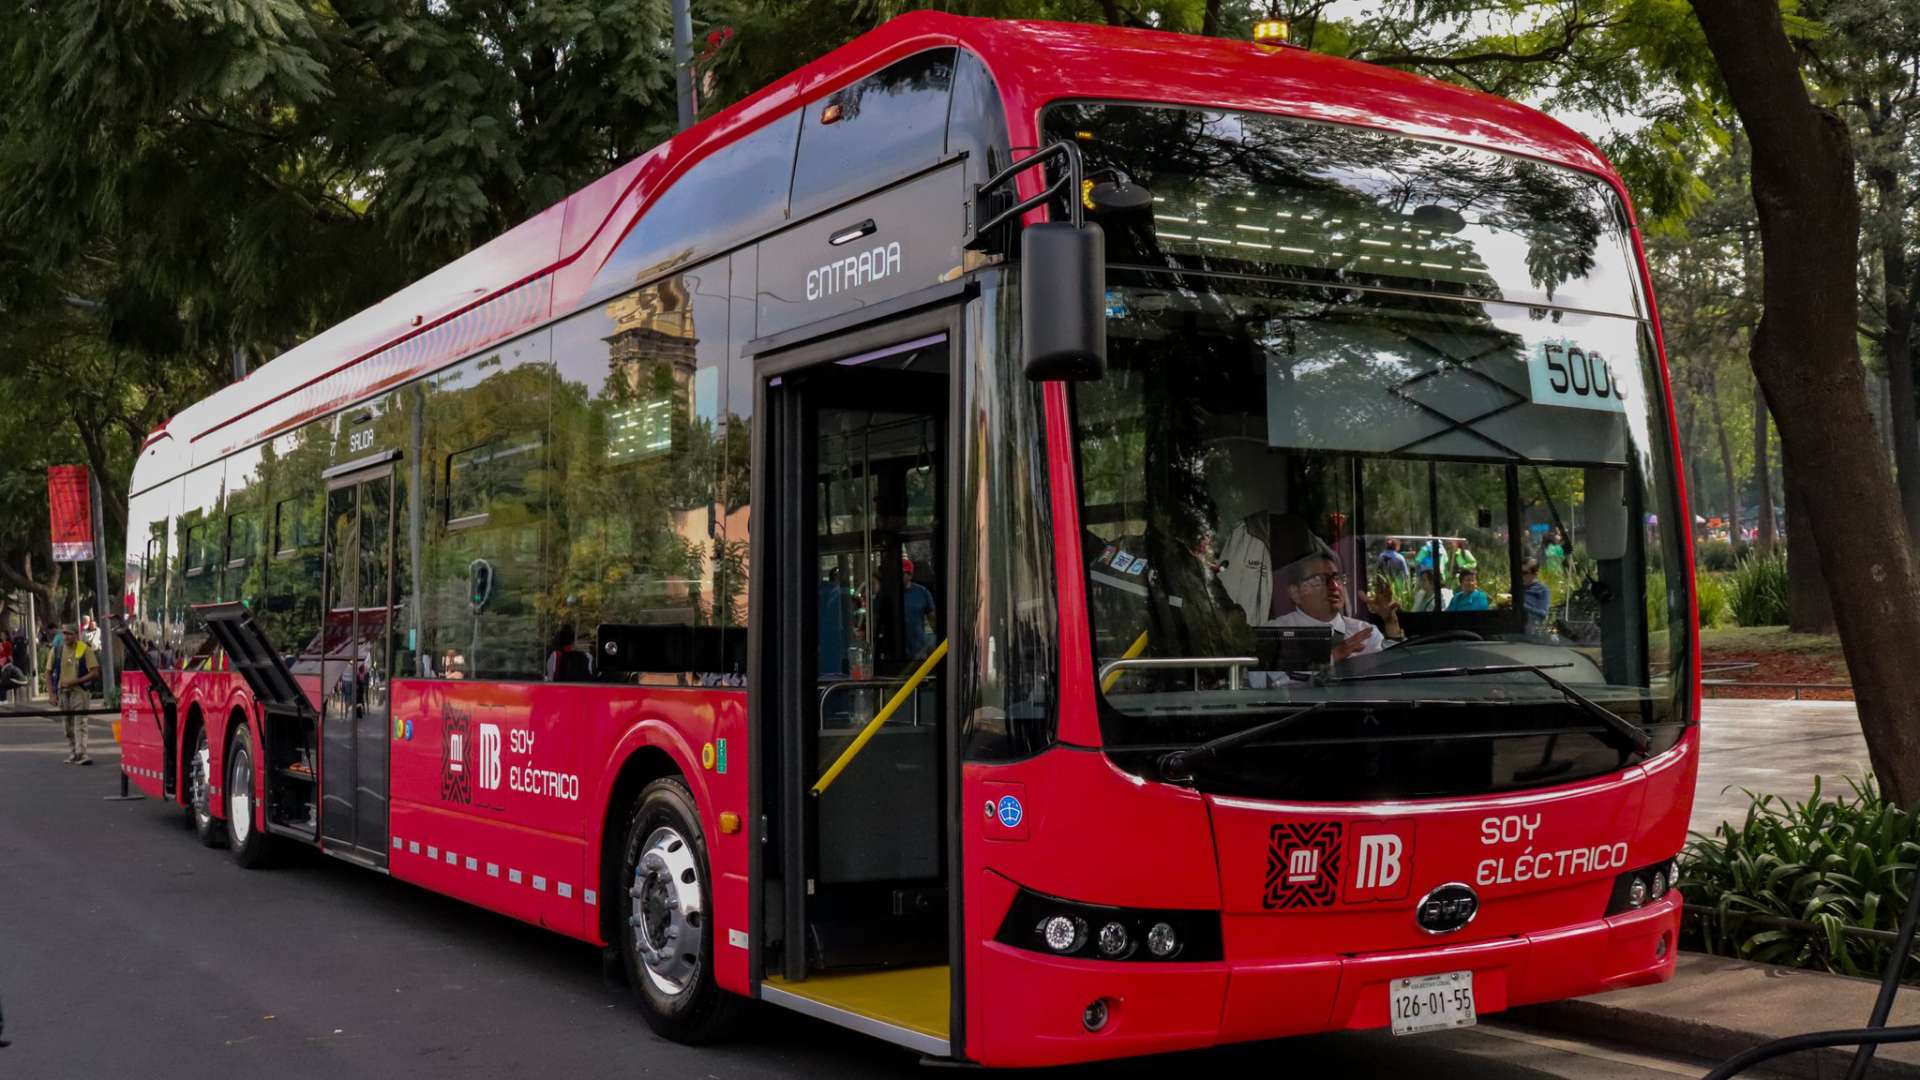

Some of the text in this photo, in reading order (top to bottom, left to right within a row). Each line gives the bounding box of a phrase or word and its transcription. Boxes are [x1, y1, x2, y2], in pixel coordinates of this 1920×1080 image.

[806, 241, 901, 301] ENTRADA
[350, 429, 374, 452] SALIDA
[479, 723, 501, 790] MB
[510, 728, 535, 755] SOY
[510, 760, 579, 801] ELÉCTRICO
[1480, 813, 1542, 845] SOY
[1355, 833, 1403, 889] MB
[1476, 842, 1628, 886] ELÉCTRICO
[1395, 988, 1471, 1019] 126-01-55
